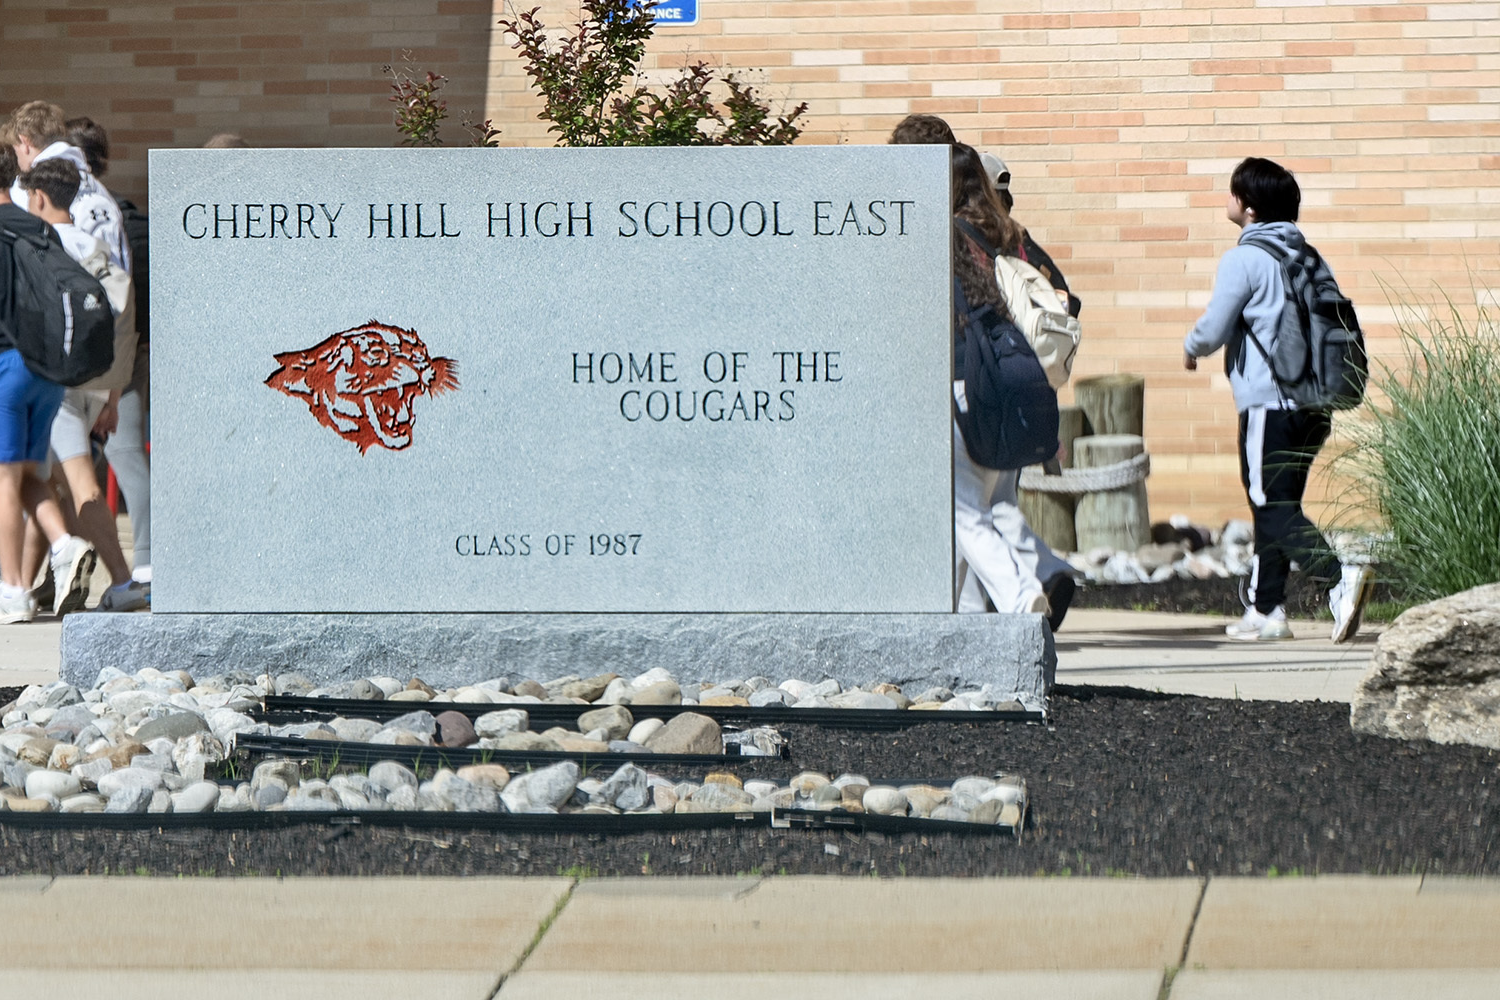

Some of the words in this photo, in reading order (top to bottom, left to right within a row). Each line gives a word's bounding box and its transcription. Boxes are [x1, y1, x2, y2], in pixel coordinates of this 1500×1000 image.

[617, 7, 683, 19] ANCE
[181, 203, 346, 240] CHERRY
[367, 203, 462, 240] HILL
[486, 202, 594, 239] HIGH
[618, 201, 796, 239] SCHOOL
[812, 200, 916, 238] EAST
[571, 352, 678, 385] HOME
[703, 351, 750, 385] OF
[772, 351, 844, 384] THE
[619, 390, 797, 424] COUGARS
[455, 534, 532, 557] CLASS
[545, 535, 577, 557] OF
[589, 534, 643, 557] 1987
